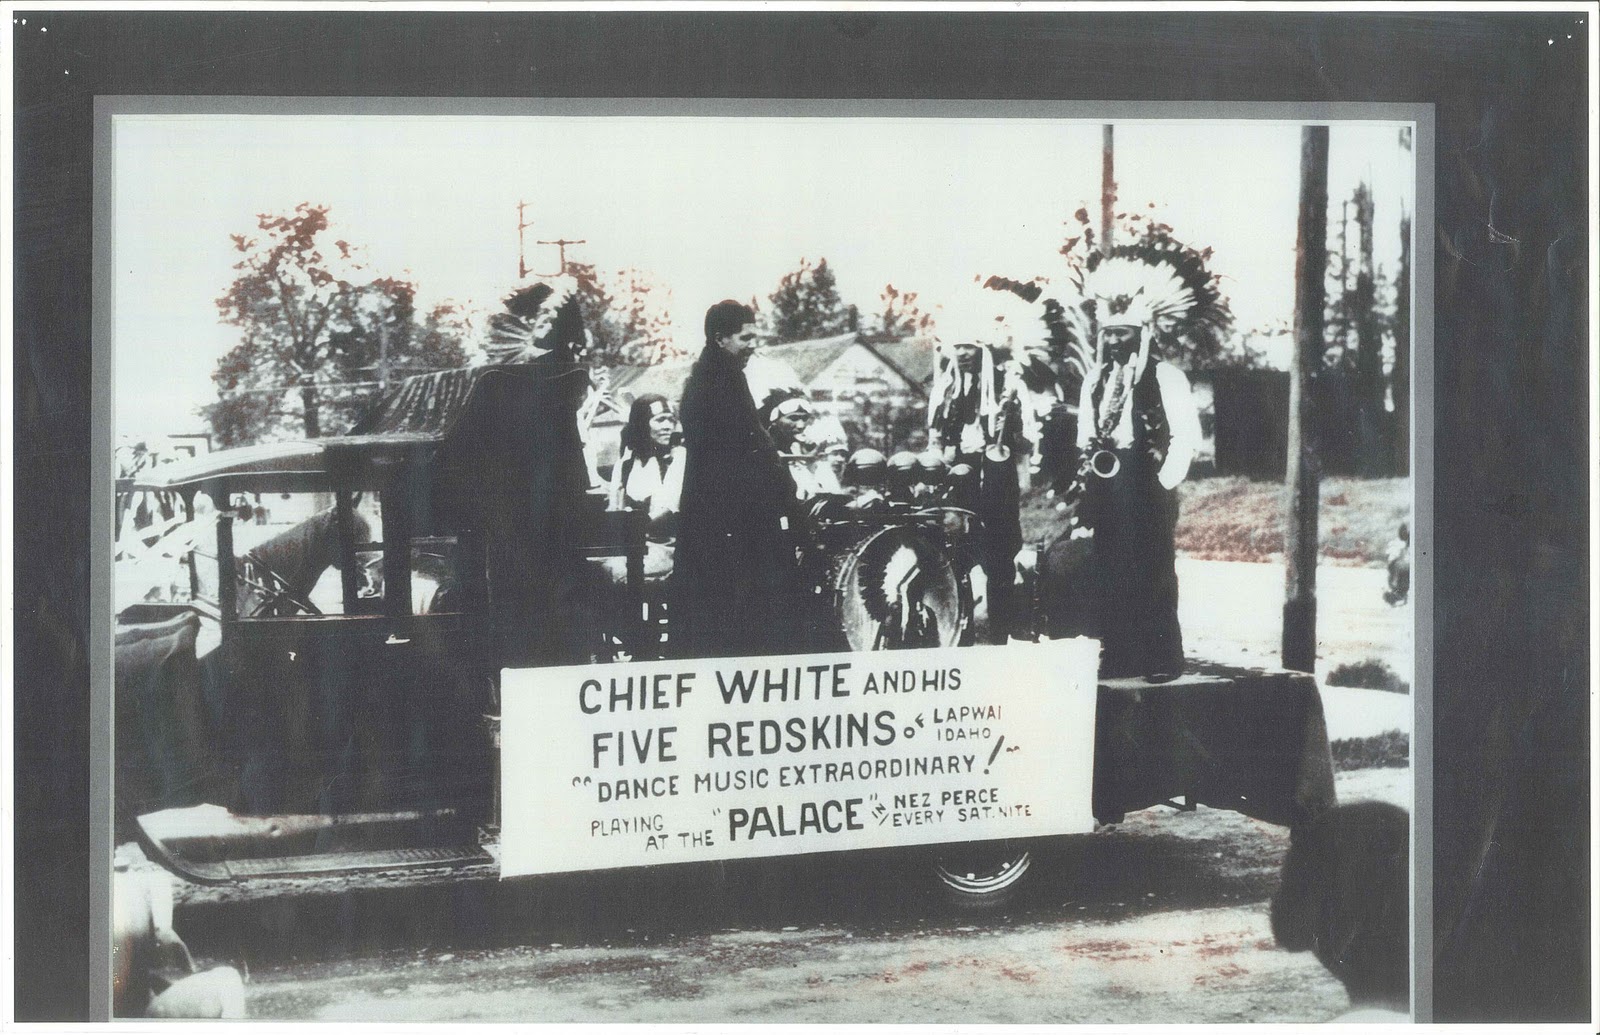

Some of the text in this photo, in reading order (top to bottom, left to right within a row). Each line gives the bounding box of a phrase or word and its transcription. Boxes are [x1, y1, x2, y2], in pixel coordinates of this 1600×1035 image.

[579, 663, 962, 715] CHIEF WHITE AND HIS
[933, 705, 1002, 724] LAPWAI
[593, 710, 925, 769] FIVE REDSKINS OF
[937, 727, 992, 741] IDAHO
[694, 768, 769, 794] MUSIC
[894, 788, 999, 809] NEZ PERCE
[591, 814, 664, 837] PLAYING
[893, 804, 1032, 827] EVERY SAT. NITE
[645, 834, 669, 851] AT
[677, 829, 715, 847] THE
